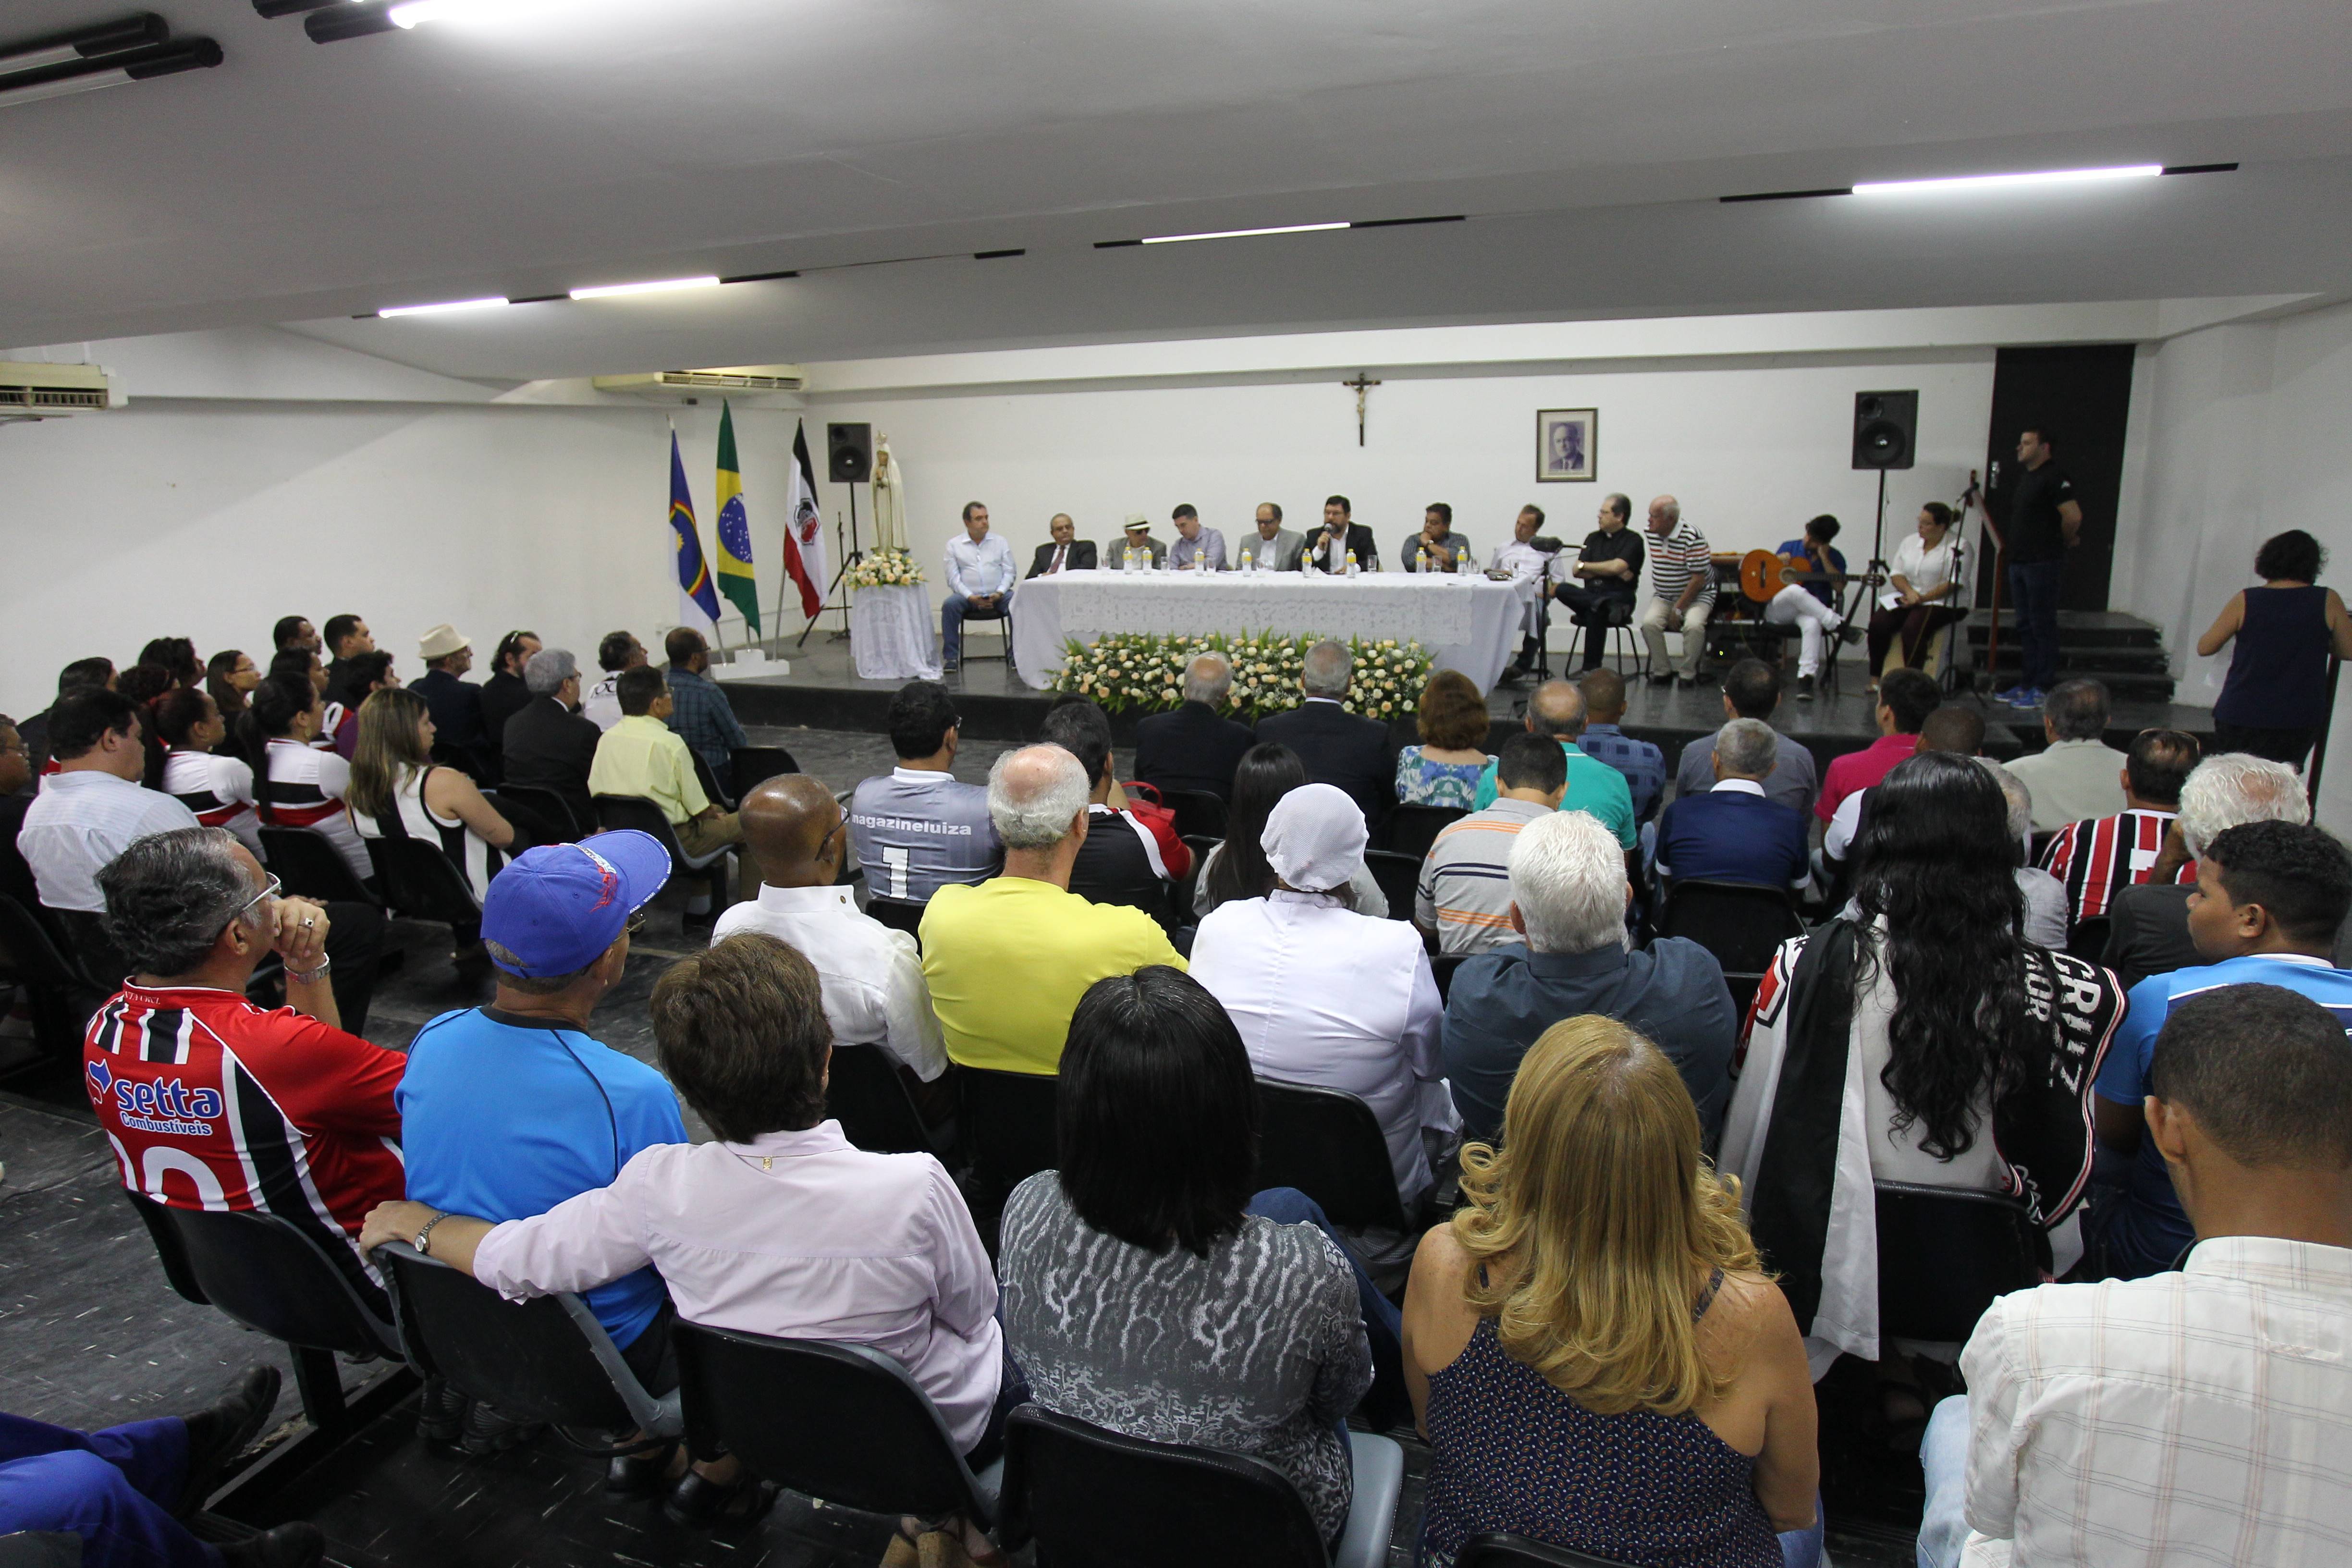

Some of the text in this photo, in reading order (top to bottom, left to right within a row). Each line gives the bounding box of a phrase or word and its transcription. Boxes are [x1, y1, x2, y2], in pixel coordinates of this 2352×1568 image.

[852, 814, 971, 835] magazineluiza
[882, 845, 909, 899] 1
[657, 878, 667, 890] MIAMI
[643, 892, 656, 903] MIAMI
[114, 1076, 223, 1118] setta
[120, 1110, 213, 1136] Combustíveis
